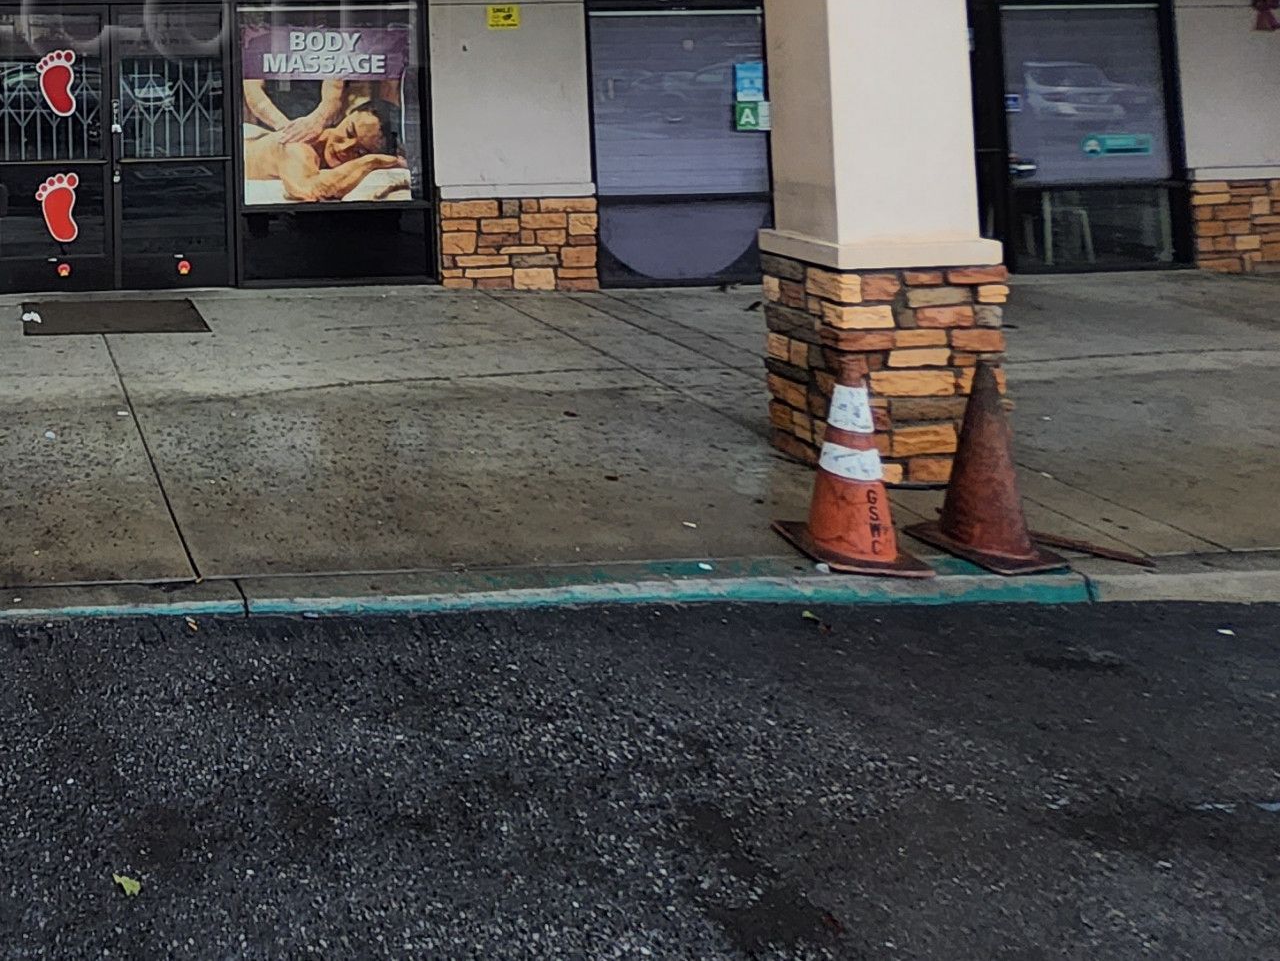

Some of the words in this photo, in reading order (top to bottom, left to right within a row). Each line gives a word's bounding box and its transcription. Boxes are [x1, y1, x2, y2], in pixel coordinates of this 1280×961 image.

[289, 31, 362, 52] BODY
[263, 53, 386, 74] MASSAGE
[740, 108, 756, 125] A
